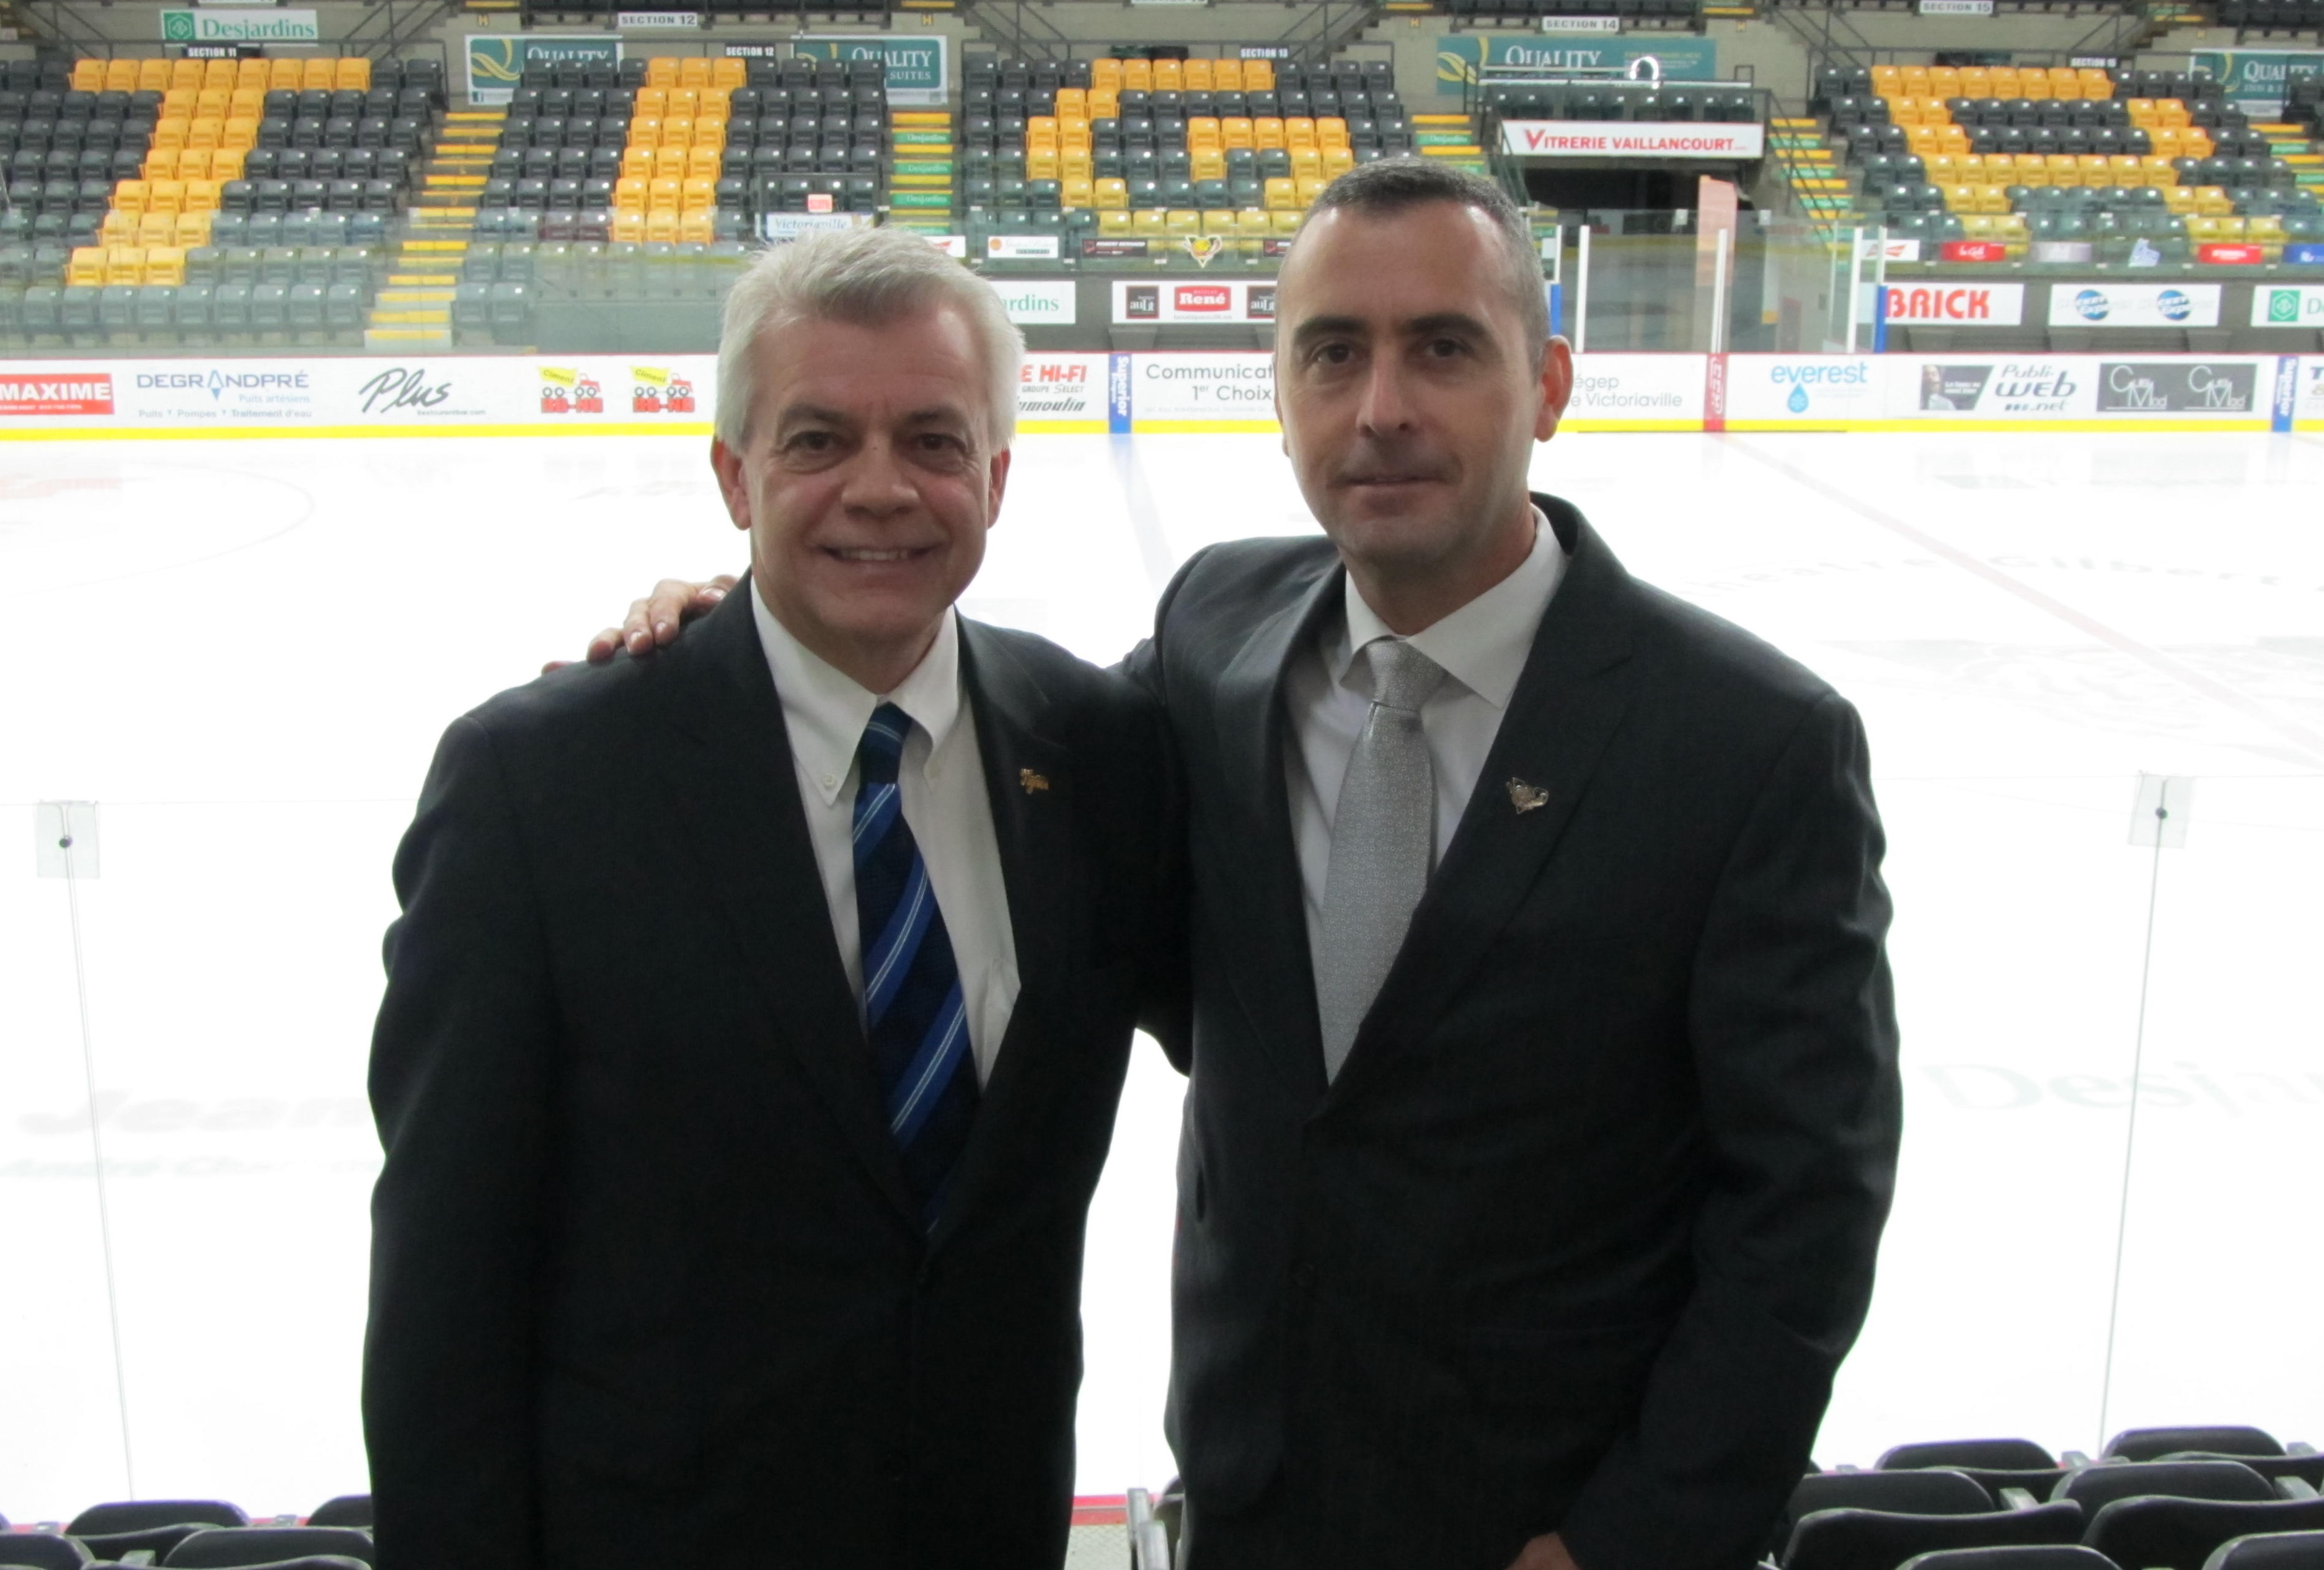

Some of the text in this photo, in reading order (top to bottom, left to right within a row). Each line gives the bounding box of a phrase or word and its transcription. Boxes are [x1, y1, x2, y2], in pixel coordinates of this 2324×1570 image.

[1924, 2, 1972, 11] SECTION
[622, 15, 696, 24] SECTION 12
[1547, 20, 1617, 29] SECTION 14
[203, 18, 315, 39] Desjardins
[188, 48, 237, 57] SECTION 11
[726, 46, 774, 56] SECTION 12
[1240, 48, 1275, 58] SECTION
[1505, 45, 1601, 68] QUALITY
[890, 71, 931, 80] SUITES
[1525, 128, 1734, 151] VITRERIE VAILLANCOURT
[1179, 292, 1226, 304] René
[1886, 288, 1990, 319] BRICK
[543, 369, 575, 384] Ciment
[635, 368, 667, 384] Ciment
[1039, 364, 1087, 382] HI-FI
[1146, 363, 1273, 379] Communicat
[1771, 361, 1868, 384] everest
[1053, 384, 1085, 394] SELECT
[1112, 356, 1131, 417] Superior
[1574, 373, 1620, 392] égep
[0, 382, 112, 401] MAXIME
[358, 368, 453, 413] Plus
[1193, 385, 1273, 400] 1er Choix
[239, 394, 311, 403] Puits artésiens
[1017, 397, 1087, 412] umoulin
[1570, 392, 1683, 407] e Victoriaville
[139, 409, 312, 419] Puits Pompes Traitement d'eau
